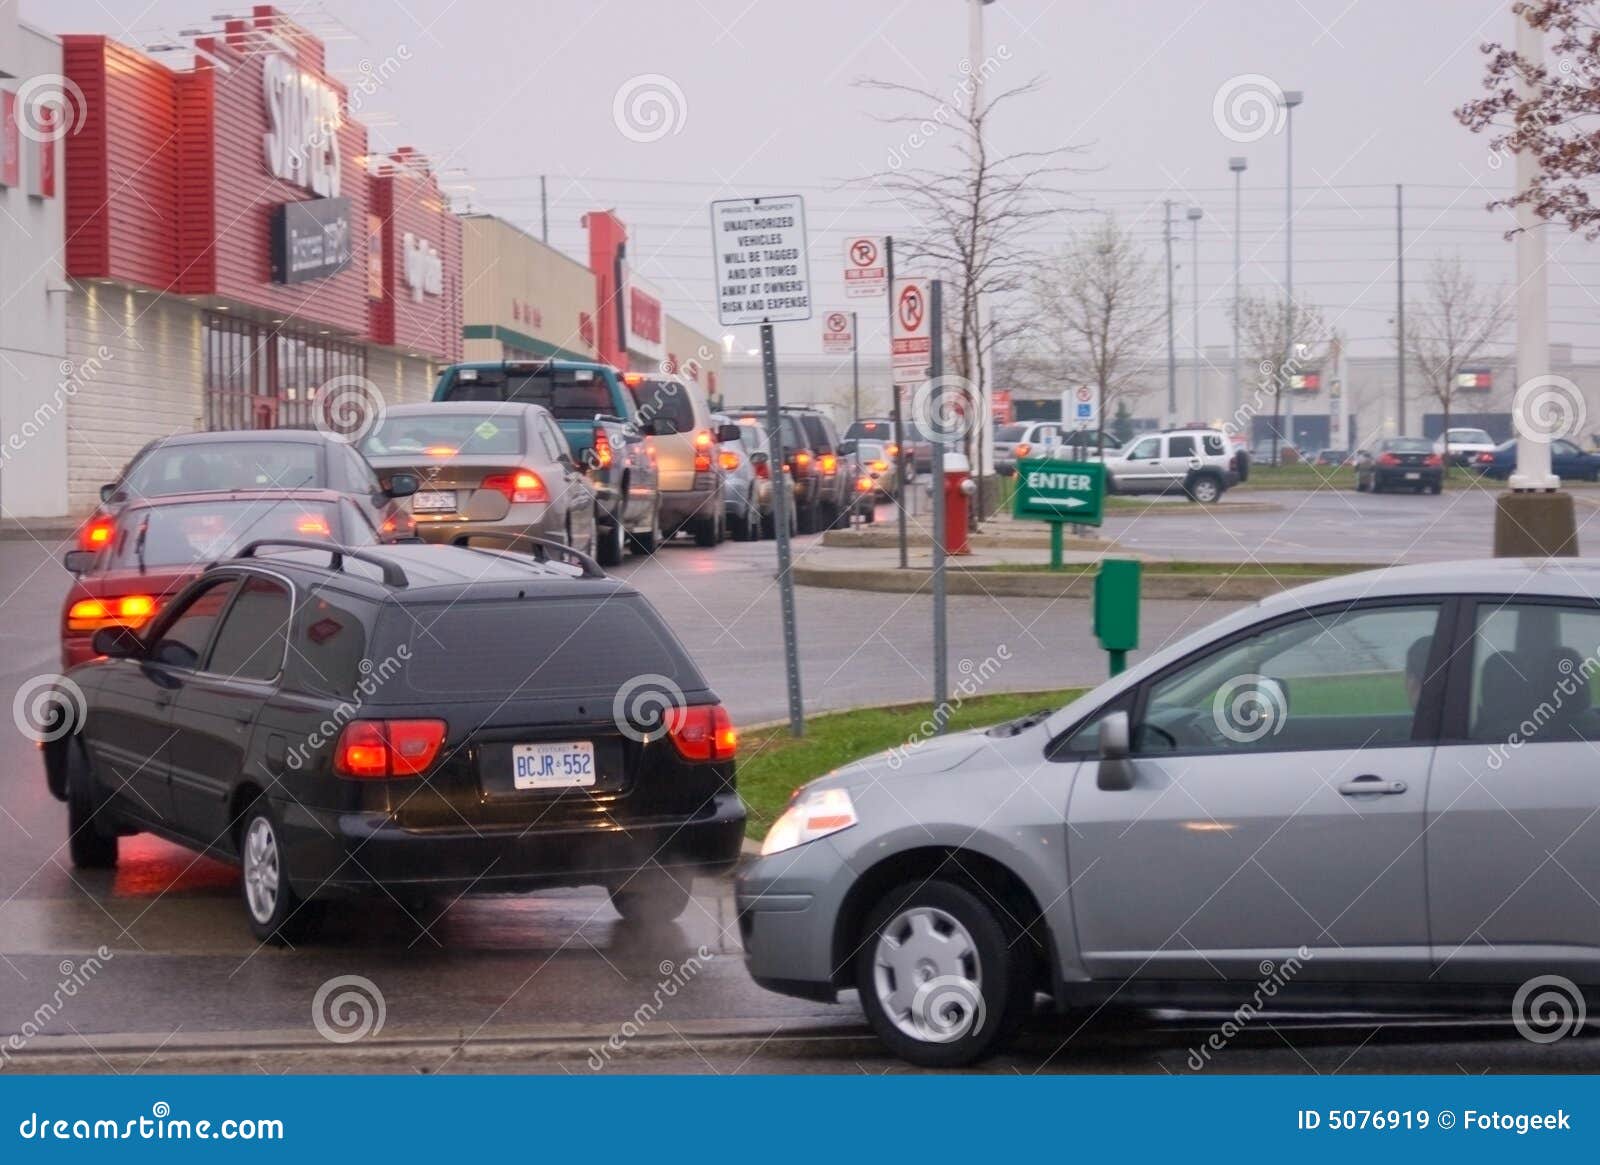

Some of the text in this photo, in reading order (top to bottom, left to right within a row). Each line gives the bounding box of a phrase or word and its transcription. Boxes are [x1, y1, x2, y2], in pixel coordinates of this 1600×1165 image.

[723, 216, 794, 231] UNAUTHORIZED
[737, 233, 782, 247] VEHICLES
[724, 248, 798, 264] WILL BE TAGGED
[728, 265, 797, 280] AND/OR TOWED
[722, 284, 747, 297] AWAY
[750, 283, 760, 294] AT
[722, 296, 808, 313] RISK AND EXPENSE
[1027, 472, 1092, 491] ENTER
[517, 753, 591, 777] BCJR 552
